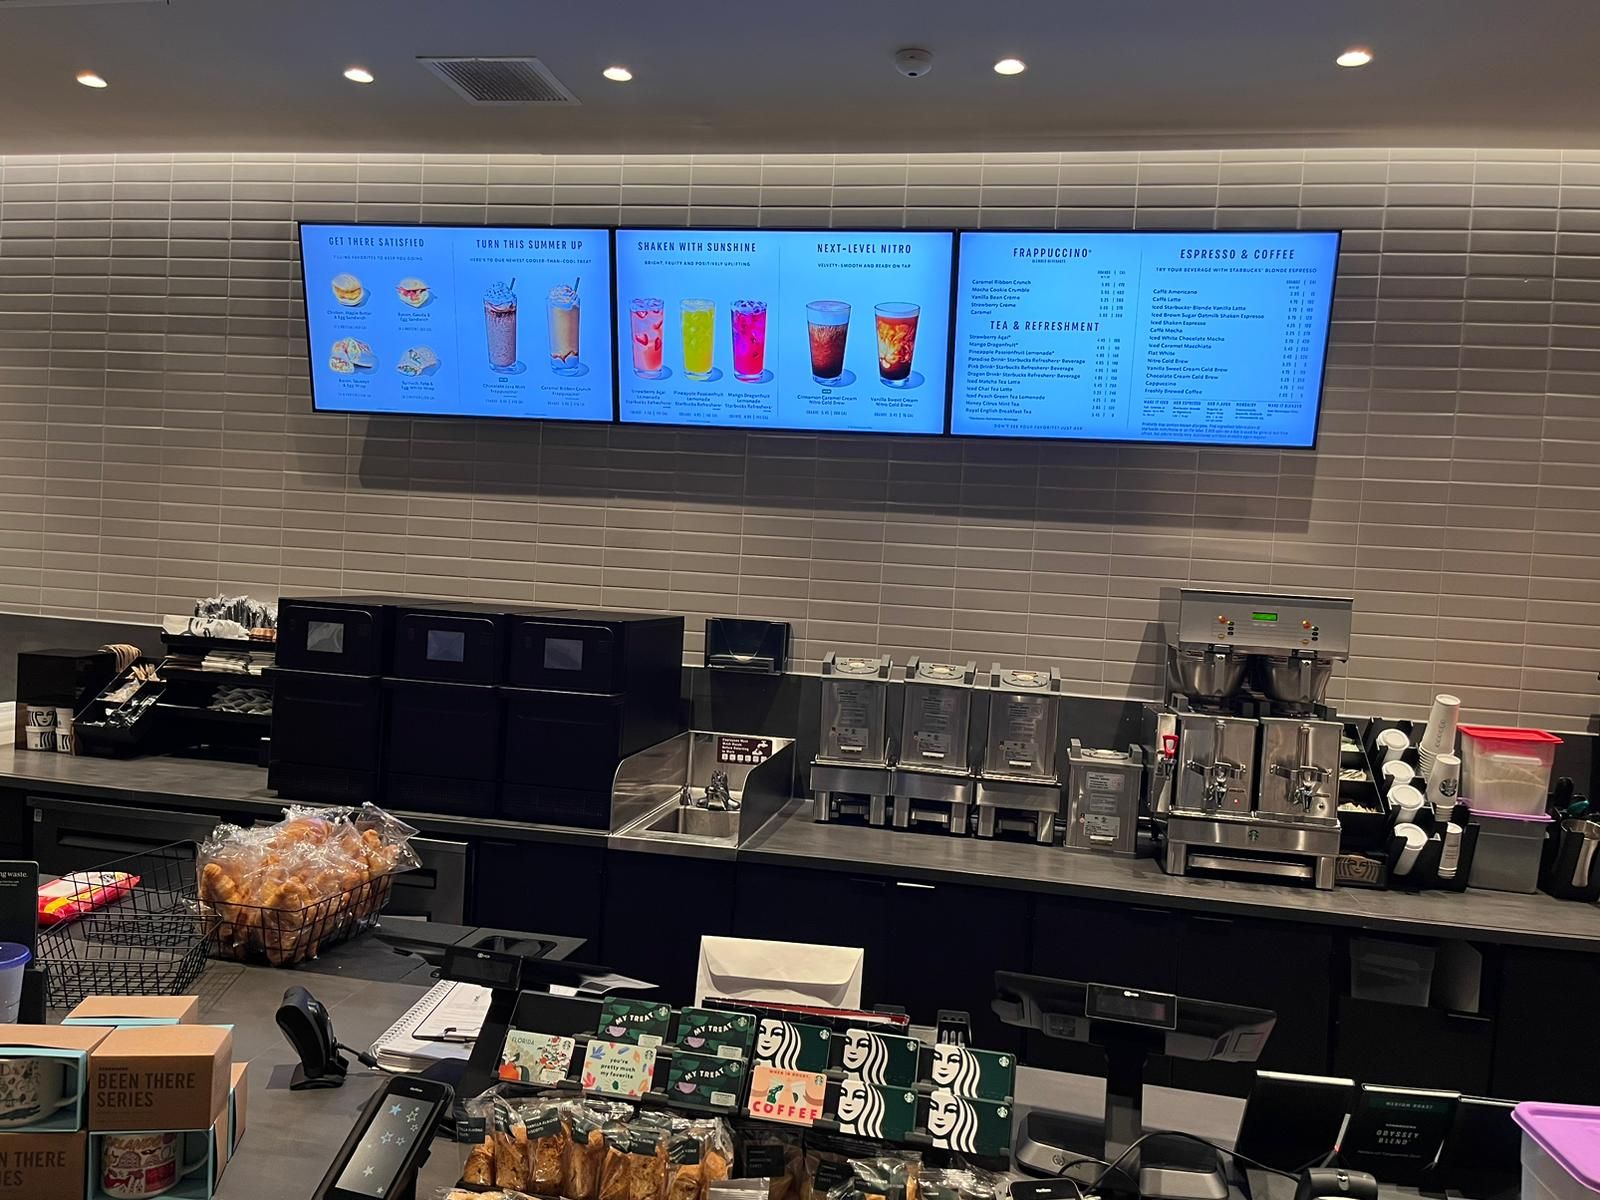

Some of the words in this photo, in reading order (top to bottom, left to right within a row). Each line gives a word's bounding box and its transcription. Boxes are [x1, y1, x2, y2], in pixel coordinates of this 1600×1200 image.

[329, 237, 343, 246] GET
[348, 237, 374, 247] THERE
[379, 238, 424, 247] SATISFIED
[476, 239, 499, 248] TURN
[503, 240, 524, 249] THIS
[528, 240, 566, 250] SUMMER
[571, 240, 582, 250] UP
[638, 241, 674, 251] SHAKEN
[679, 242, 703, 251] WITH
[707, 242, 756, 252] SUNSHINE
[817, 244, 876, 253] NEXT-LEVEL
[881, 244, 911, 254] NITRO
[1180, 249, 1236, 259] ESPRESSO
[1241, 249, 1248, 259] &
[1254, 249, 1295, 259] COFFEE
[990, 320, 1008, 330] TEA
[1013, 321, 1019, 330] &
[1025, 321, 1099, 331] REFRESHMENT
[615, 1014, 627, 1025] MY
[630, 1012, 654, 1022] TREAT
[693, 1026, 705, 1036] MY
[708, 1022, 733, 1032] TREAT
[512, 1037, 534, 1045] FLORIDA
[684, 1071, 697, 1081] MY
[700, 1067, 725, 1078] TREAT
[98, 1072, 139, 1089] BEEN
[144, 1072, 196, 1089] THERE
[97, 1091, 153, 1108] SERIES
[753, 1101, 817, 1120] COFFEE
[1376, 1130, 1419, 1139] ODYSSEY
[14, 1152, 66, 1168] THERE
